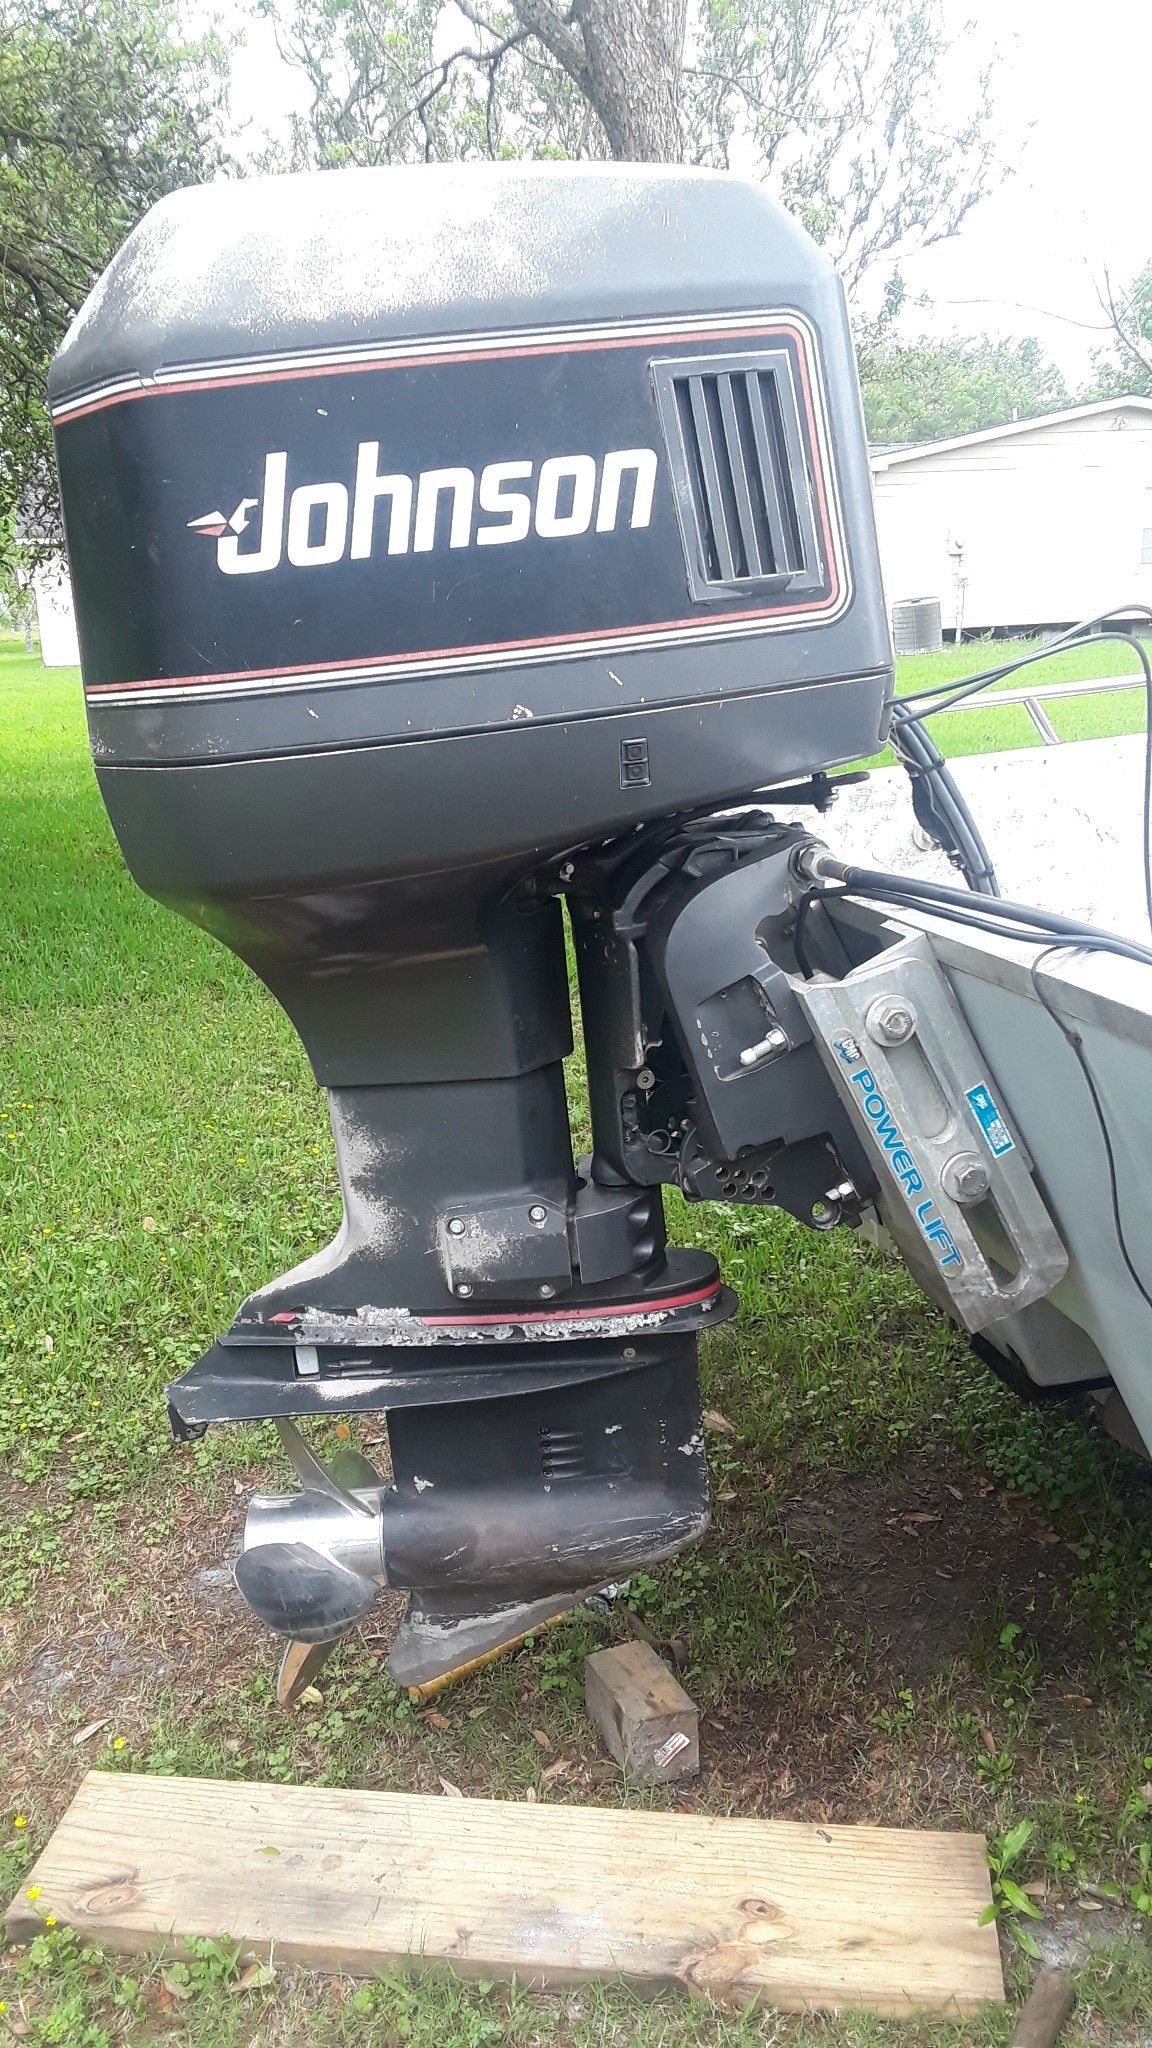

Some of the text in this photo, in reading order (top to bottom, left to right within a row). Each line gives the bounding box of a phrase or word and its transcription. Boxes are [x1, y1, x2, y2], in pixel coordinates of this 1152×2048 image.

[216, 441, 658, 575] Johnson
[850, 1067, 963, 1266] POWER LIFT
